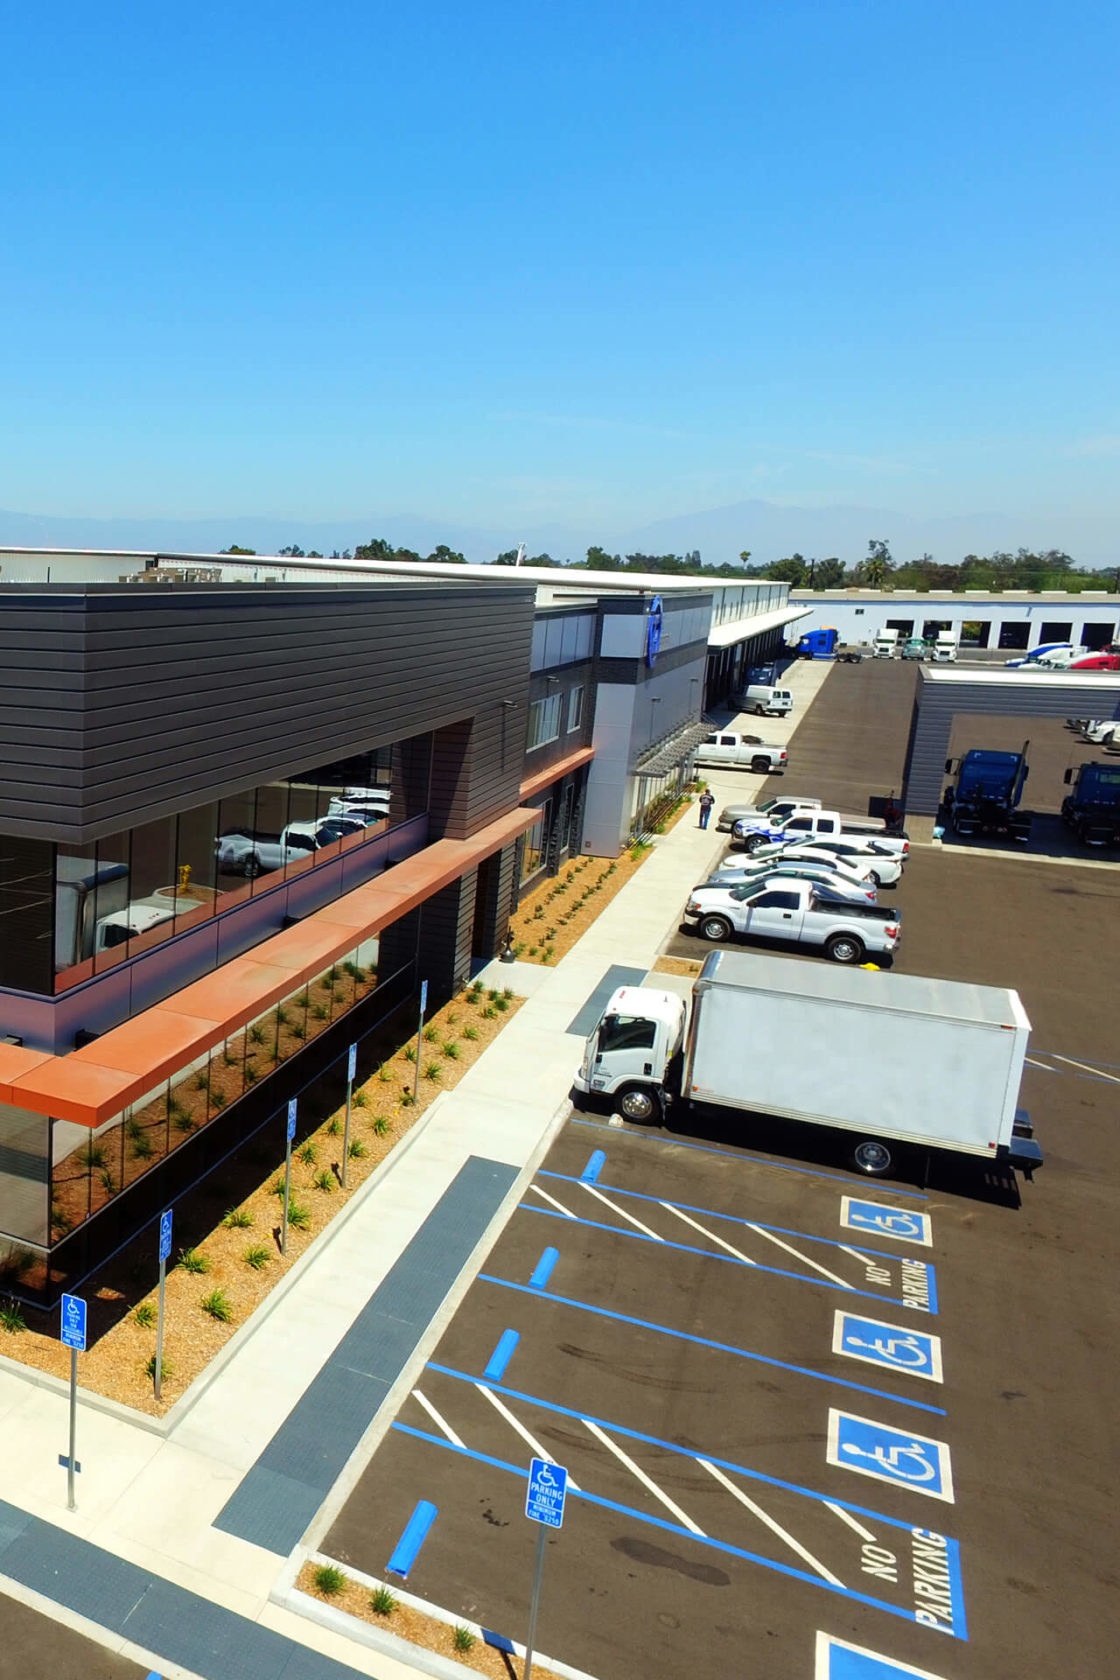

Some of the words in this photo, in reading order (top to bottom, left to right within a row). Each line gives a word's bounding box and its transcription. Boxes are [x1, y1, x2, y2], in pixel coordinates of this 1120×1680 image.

[865, 1265, 891, 1287] NO
[902, 1258, 930, 1313] PARKING
[531, 1482, 563, 1501] PARKING
[536, 1494, 556, 1507] ONLY
[860, 1543, 898, 1583] NO
[911, 1527, 955, 1636] PARKING
